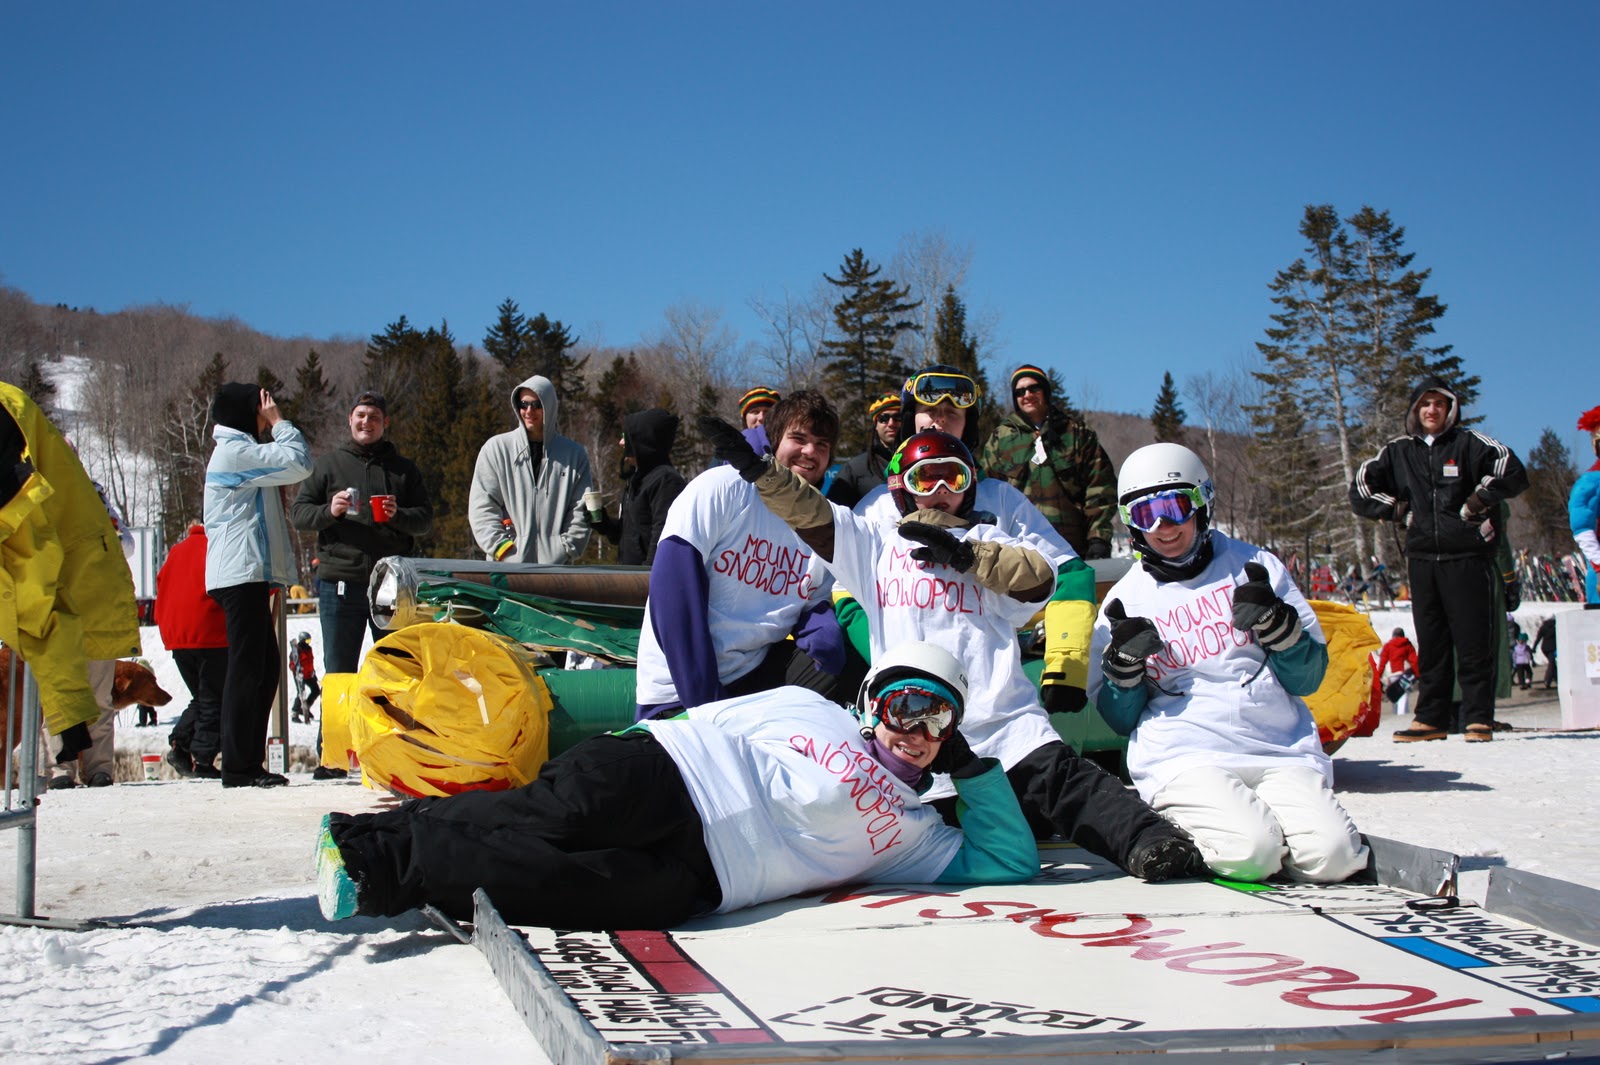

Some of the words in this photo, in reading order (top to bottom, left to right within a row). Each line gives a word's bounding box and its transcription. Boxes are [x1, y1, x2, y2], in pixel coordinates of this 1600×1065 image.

[743, 533, 811, 574] MOUNT
[876, 577, 983, 616] NOWOPOLY
[1155, 584, 1234, 639] MOUNT
[789, 734, 903, 856] SNOWOPOLY
[581, 964, 656, 991] Cloud
[1500, 973, 1593, 994] SKI
[869, 992, 1107, 1030] FOUND
